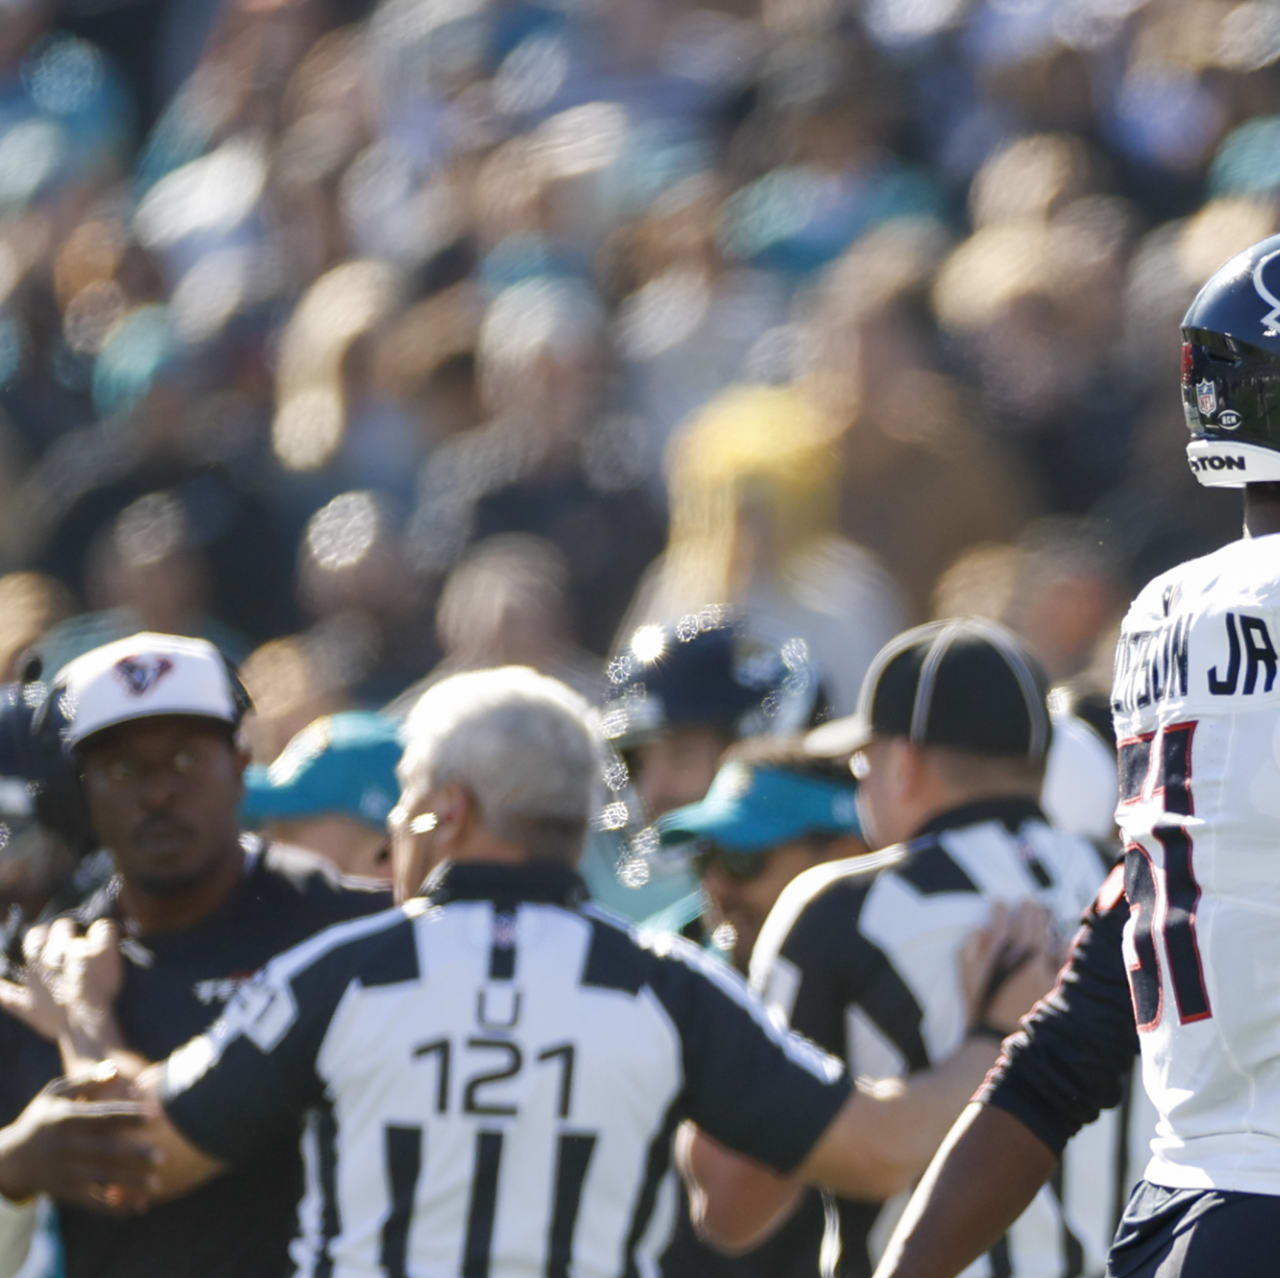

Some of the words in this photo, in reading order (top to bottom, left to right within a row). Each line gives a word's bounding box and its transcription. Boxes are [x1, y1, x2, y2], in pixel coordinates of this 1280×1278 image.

[1208, 612, 1278, 696] JR
[478, 992, 523, 1031] U
[411, 1040, 575, 1118] 121
